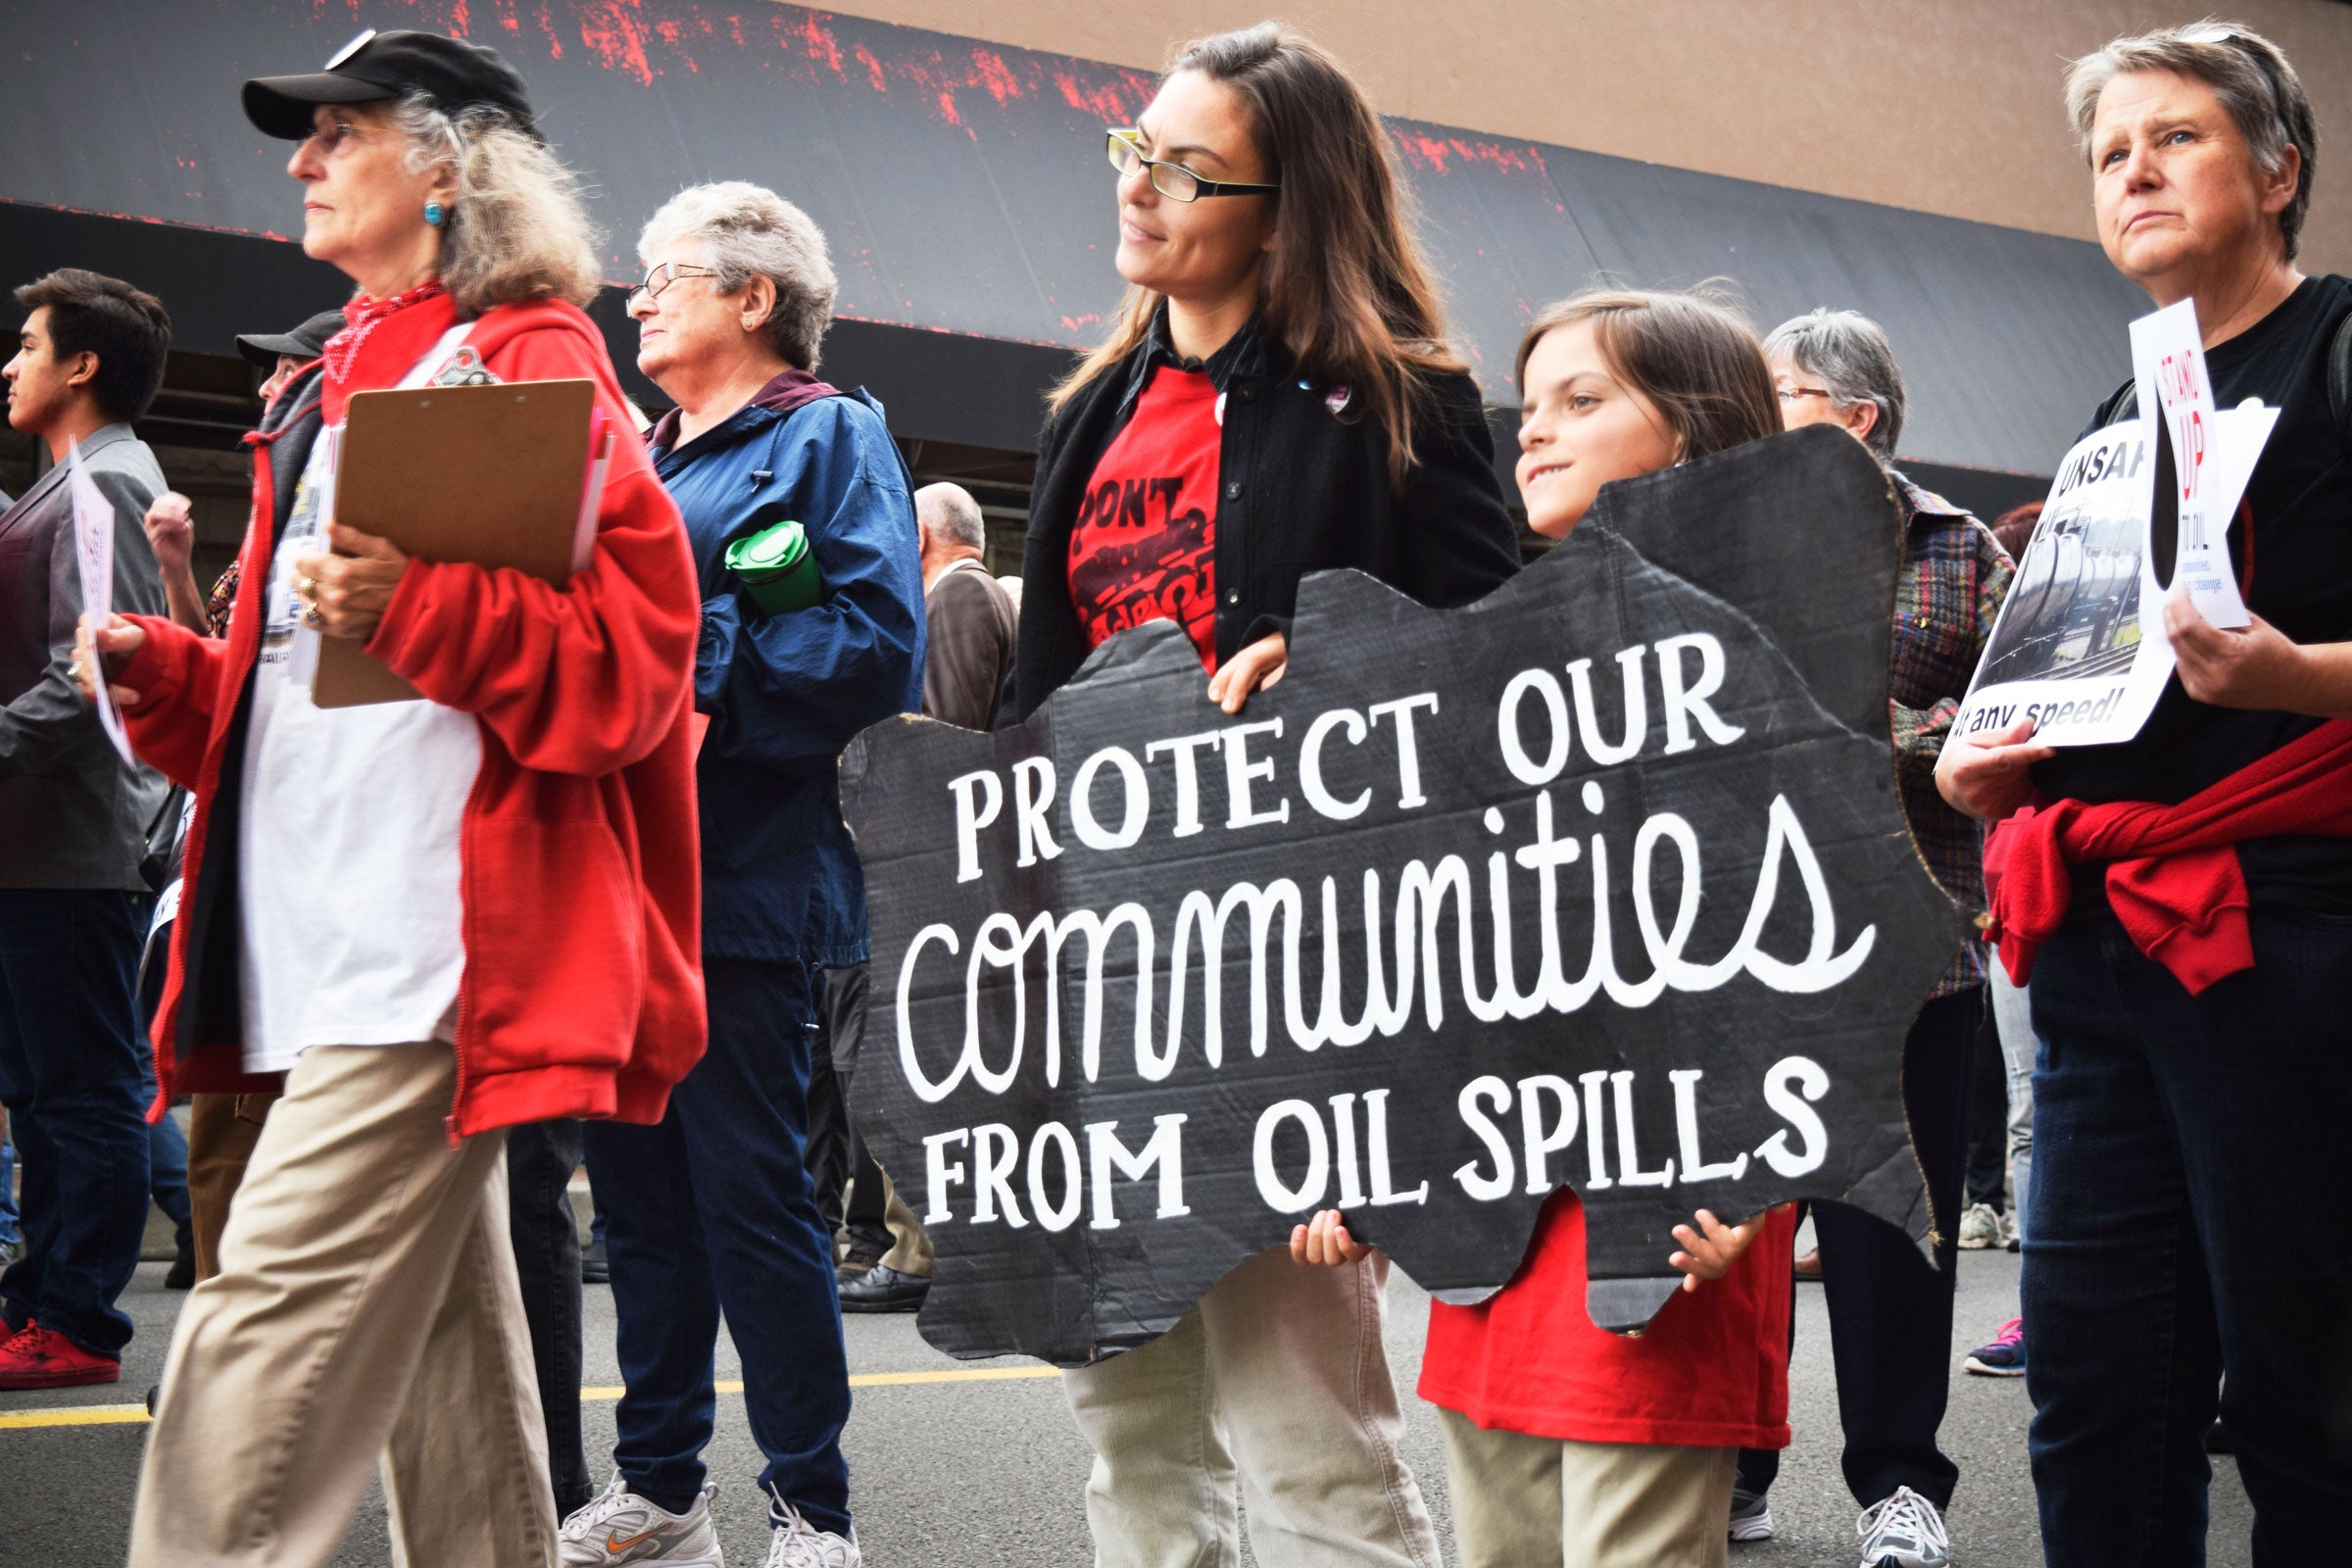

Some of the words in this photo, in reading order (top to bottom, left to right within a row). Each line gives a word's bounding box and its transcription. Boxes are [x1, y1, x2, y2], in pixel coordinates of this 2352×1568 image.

[947, 692, 1440, 884] PROTECT
[1497, 631, 1746, 786] OUR
[1970, 704, 2017, 733] any
[2025, 687, 2126, 736] speed!
[895, 780, 1877, 1103] communities
[921, 1112, 1192, 1233] FROM
[1252, 1088, 1429, 1214] OIL
[1452, 1055, 1831, 1201] SPILLS
